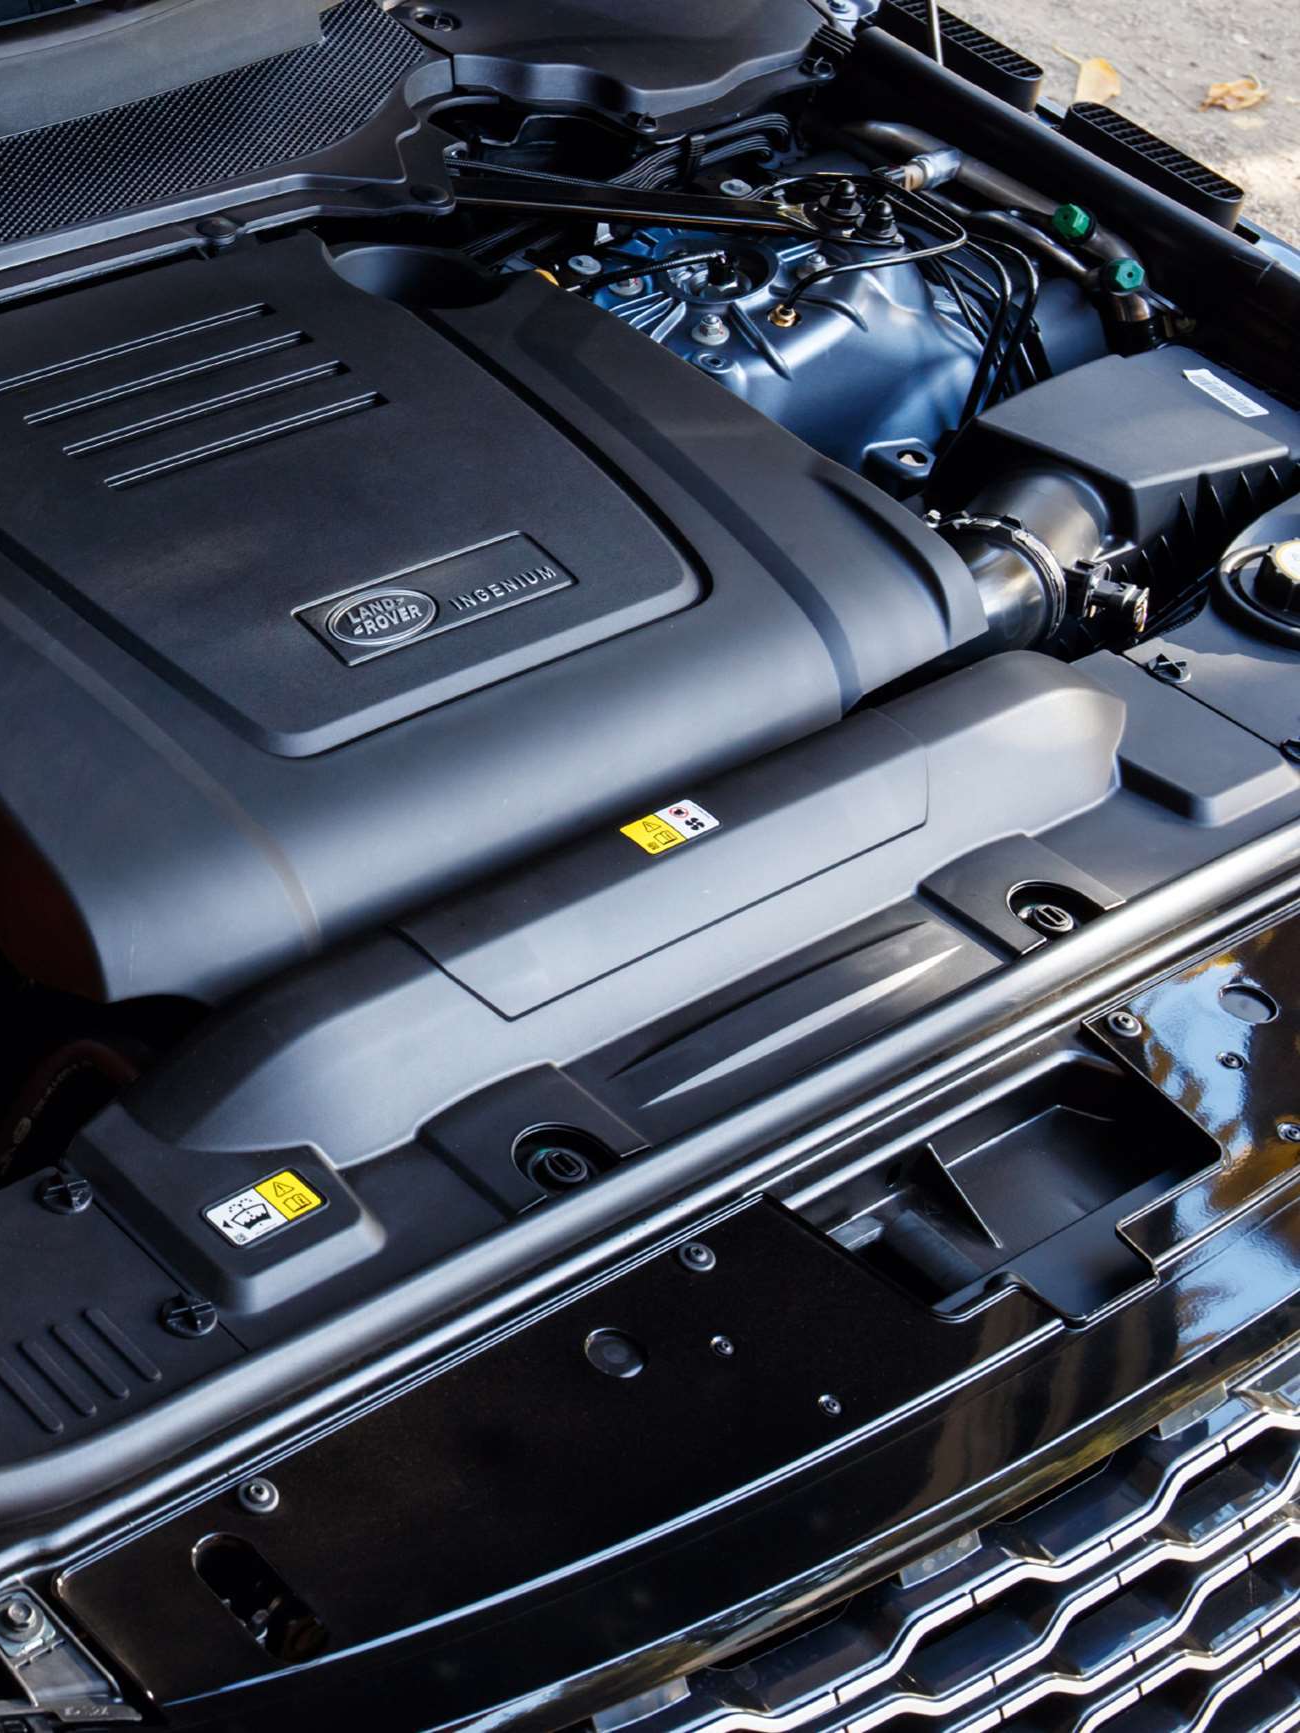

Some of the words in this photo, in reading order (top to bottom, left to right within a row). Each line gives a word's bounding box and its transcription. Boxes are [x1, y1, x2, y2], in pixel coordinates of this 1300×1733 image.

[450, 566, 557, 611] INGENIUM
[347, 597, 398, 624] LAND
[365, 604, 422, 636] ROVER
